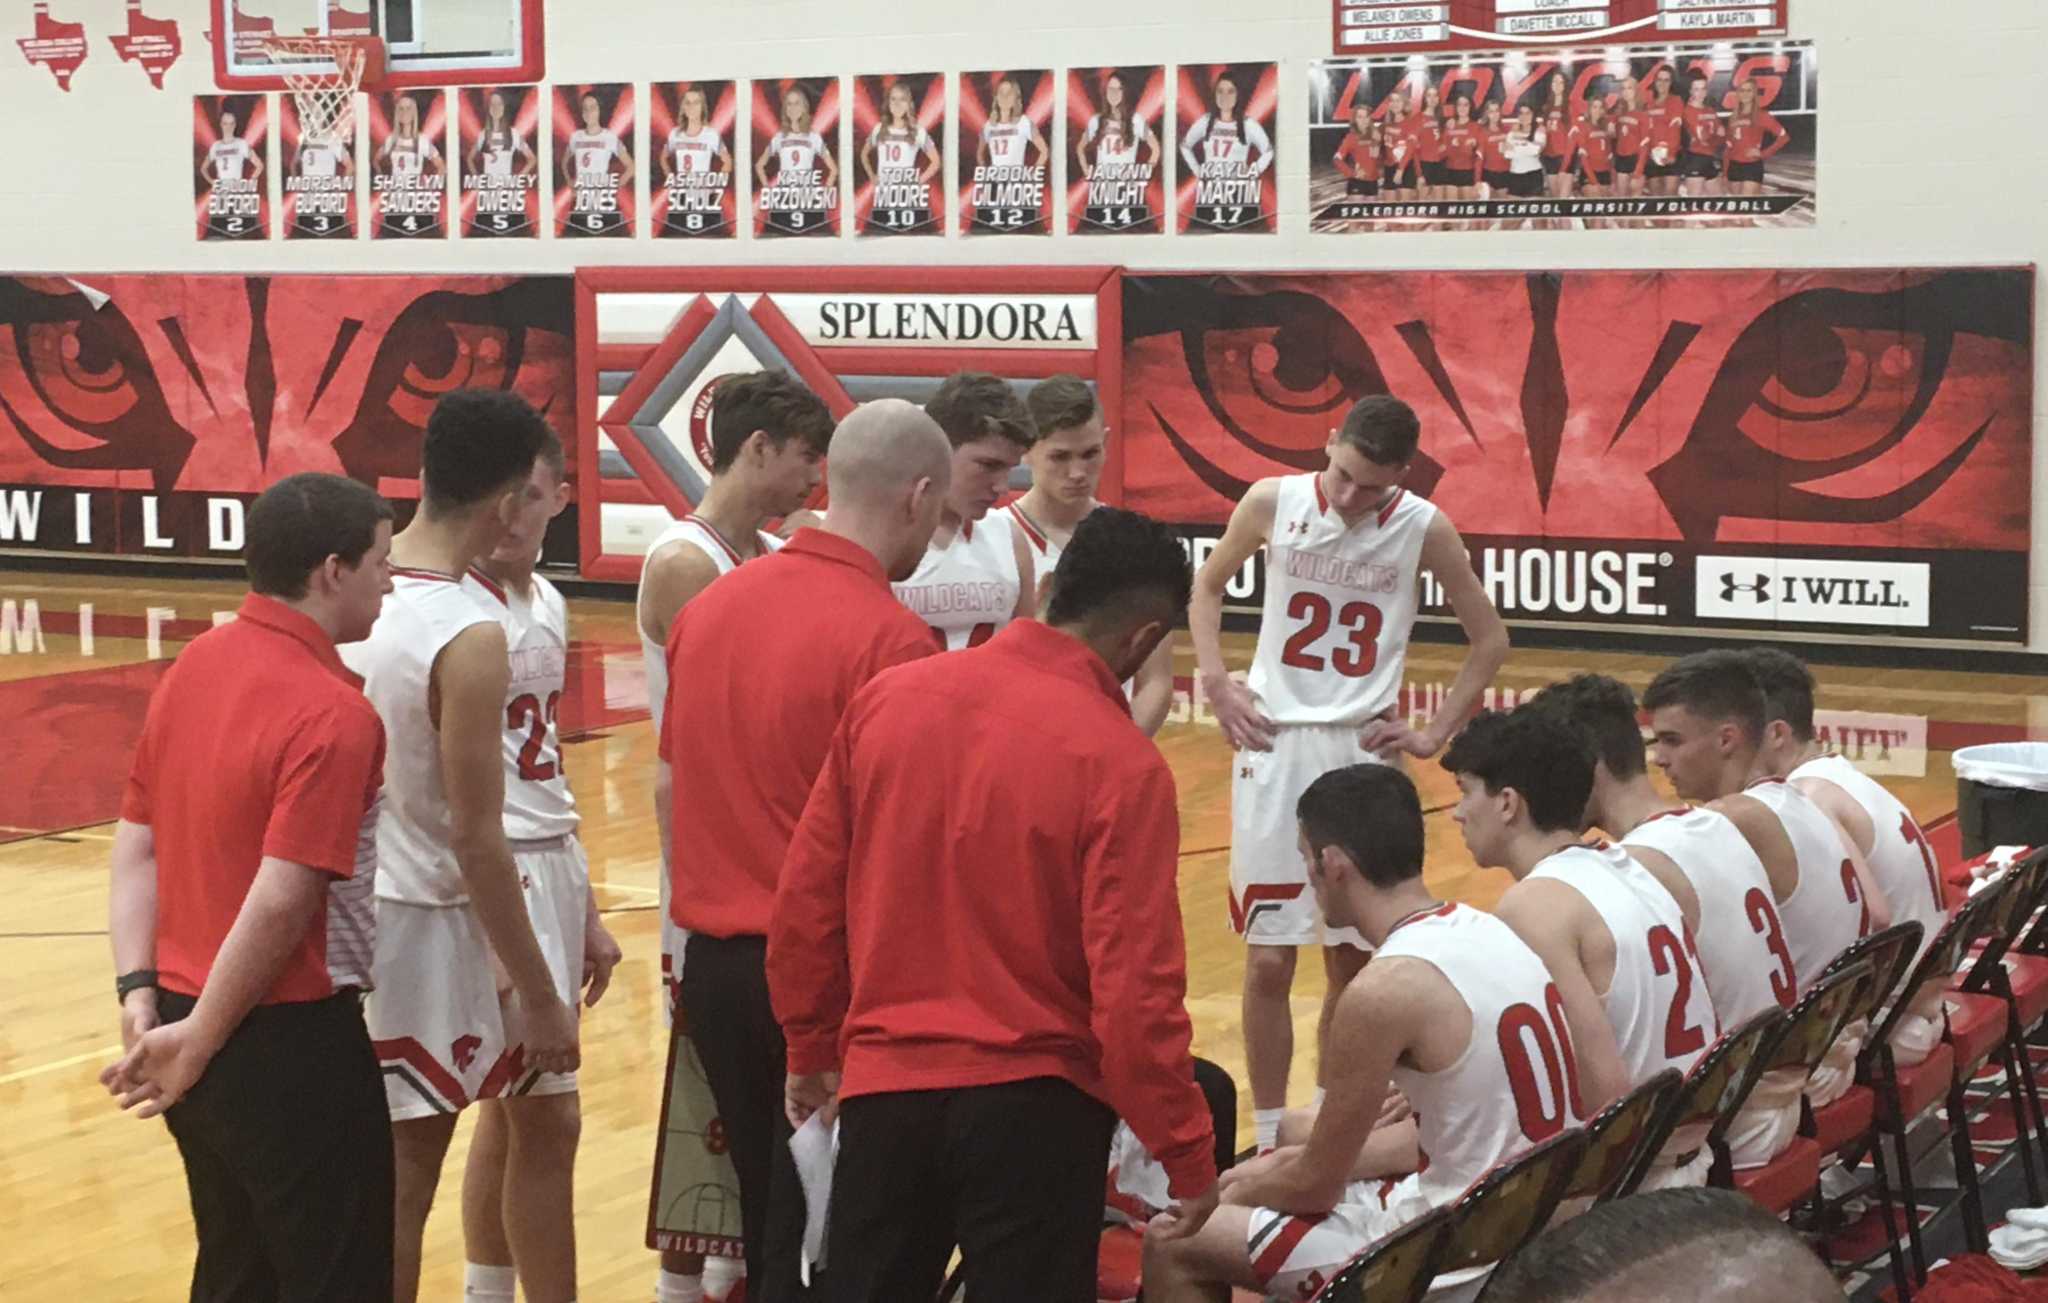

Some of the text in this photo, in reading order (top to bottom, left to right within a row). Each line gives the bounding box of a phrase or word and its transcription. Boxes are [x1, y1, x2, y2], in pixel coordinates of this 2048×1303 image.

[1352, 9, 1433, 23] MELANEY OWENS
[1510, 14, 1596, 32] DAVETTE MCCALL
[1680, 12, 1755, 26] KAYLA MARTIN
[1364, 28, 1424, 42] ALLIE JONES
[776, 169, 823, 186] KATIE
[880, 167, 921, 185] TORI
[972, 166, 1046, 182] BROOKE
[1200, 161, 1259, 179] KAYLA
[286, 175, 354, 191] MORGAN
[372, 173, 444, 191] SHAELYN
[463, 173, 537, 189] MELANEY
[574, 172, 620, 188] ALLIE
[664, 172, 730, 188] ASHTON
[574, 189, 618, 211] JONES
[667, 188, 724, 211] SCHOLZ
[759, 186, 837, 210] BRZOWSKI
[873, 184, 930, 207] MOORE
[971, 183, 1043, 207] GILMORE
[1087, 181, 1148, 206] KNIGHT
[1195, 179, 1261, 205] MARTIN
[379, 191, 442, 213] SANDERS
[476, 190, 527, 212] OWENS
[1339, 200, 1773, 217] SPLENDORA HIGH SCHOOL VARSITY VOLLEYBALL
[313, 215, 329, 231] 3
[401, 215, 418, 231] 4
[492, 214, 509, 230] 5
[586, 214, 604, 229] 6
[685, 213, 703, 229] 8
[790, 212, 804, 228] 9
[887, 210, 915, 226] 10
[989, 209, 1024, 225] 12
[1101, 208, 1132, 224] 14
[1211, 206, 1243, 224] 17
[226, 217, 244, 232] 2
[819, 300, 1081, 343] SPLENDORA
[1286, 549, 1398, 595] WILDCATS
[1782, 576, 1798, 604] I
[1280, 591, 1385, 679] 23
[1744, 886, 1799, 1011] 3
